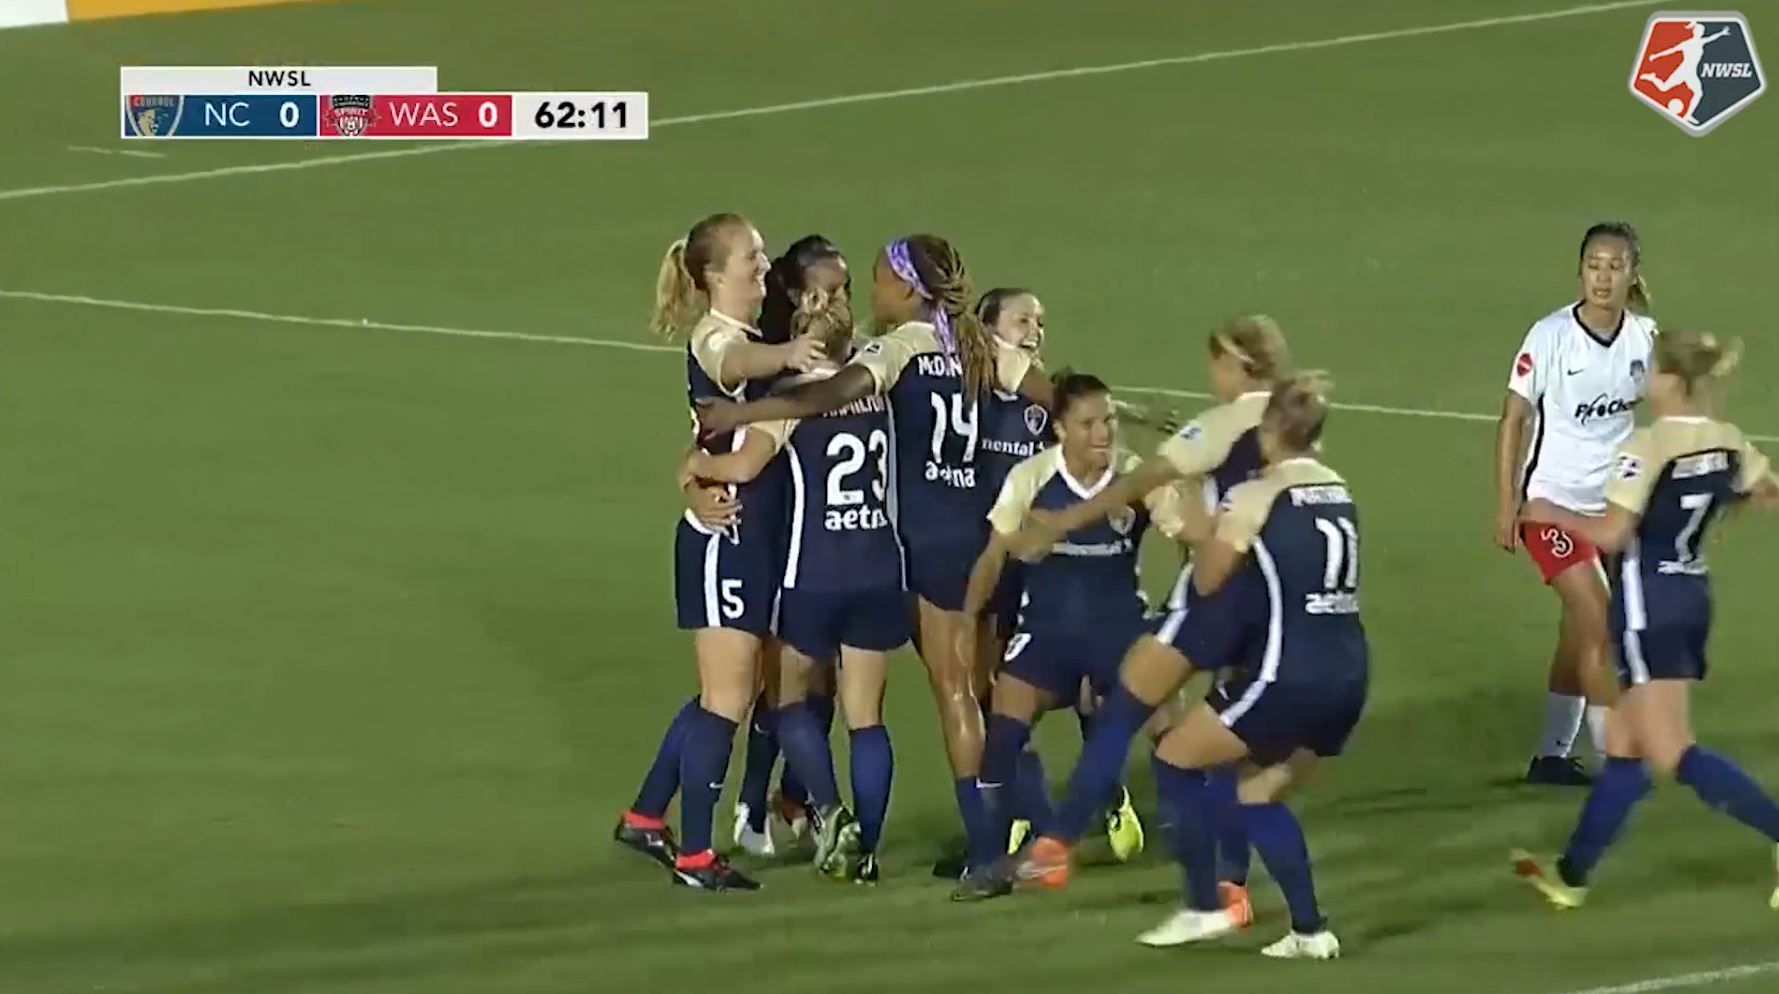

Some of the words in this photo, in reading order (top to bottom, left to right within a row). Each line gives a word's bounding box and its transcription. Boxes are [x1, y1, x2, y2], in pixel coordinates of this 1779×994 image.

[930, 391, 979, 464] 14
[826, 429, 888, 506] 23
[1315, 516, 1358, 589] 11
[1540, 528, 1574, 559] 3
[1674, 493, 1714, 563] 7
[721, 578, 745, 619] 5
